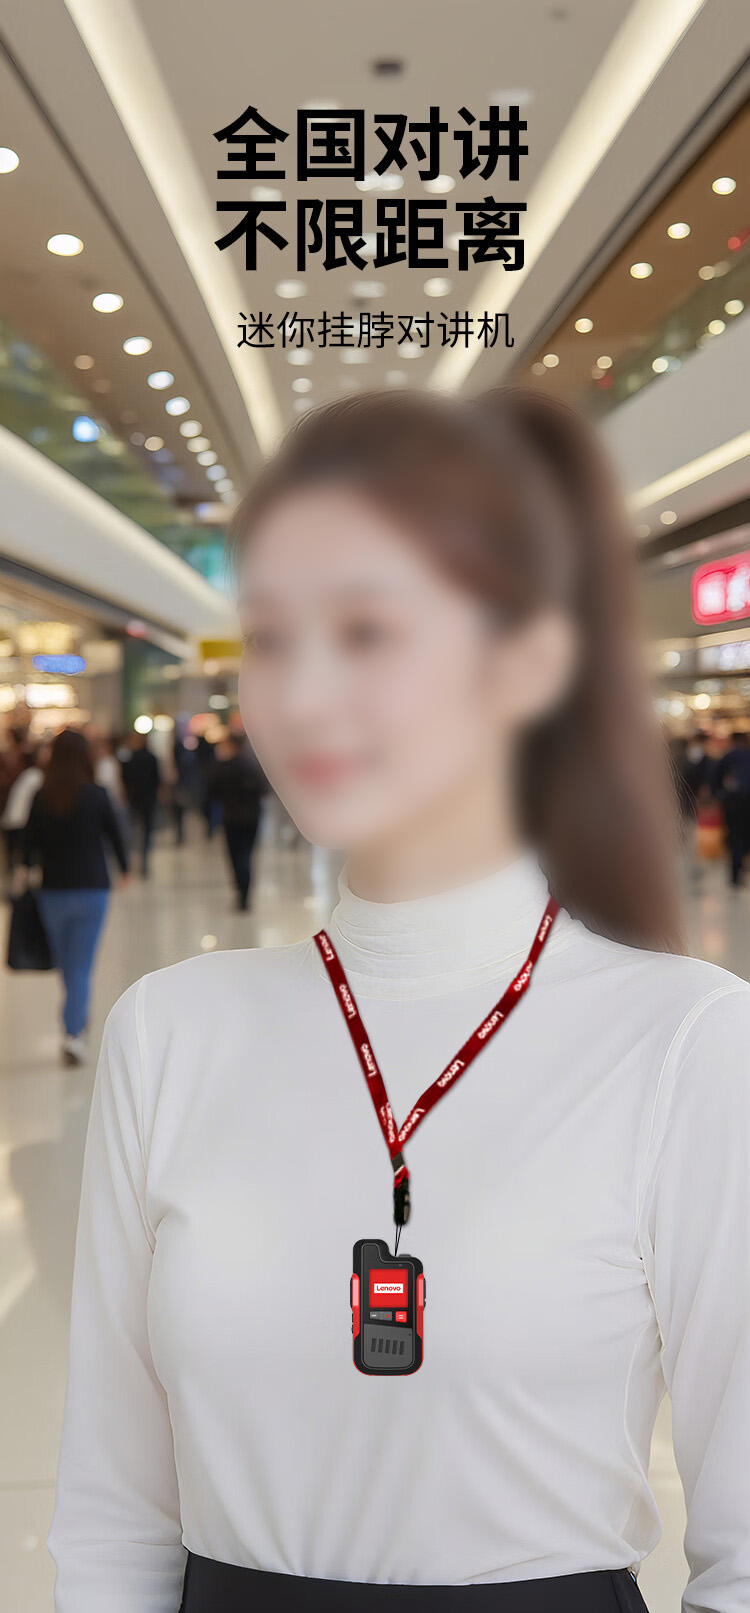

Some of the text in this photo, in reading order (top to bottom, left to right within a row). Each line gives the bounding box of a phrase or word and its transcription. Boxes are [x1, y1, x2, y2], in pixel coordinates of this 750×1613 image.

[339, 983, 357, 1019] Lenovo
[478, 1011, 504, 1039] Lenovo
[361, 1043, 378, 1077] Lenovo
[437, 1059, 465, 1087] Lenovo
[398, 1108, 426, 1141] Lenovo
